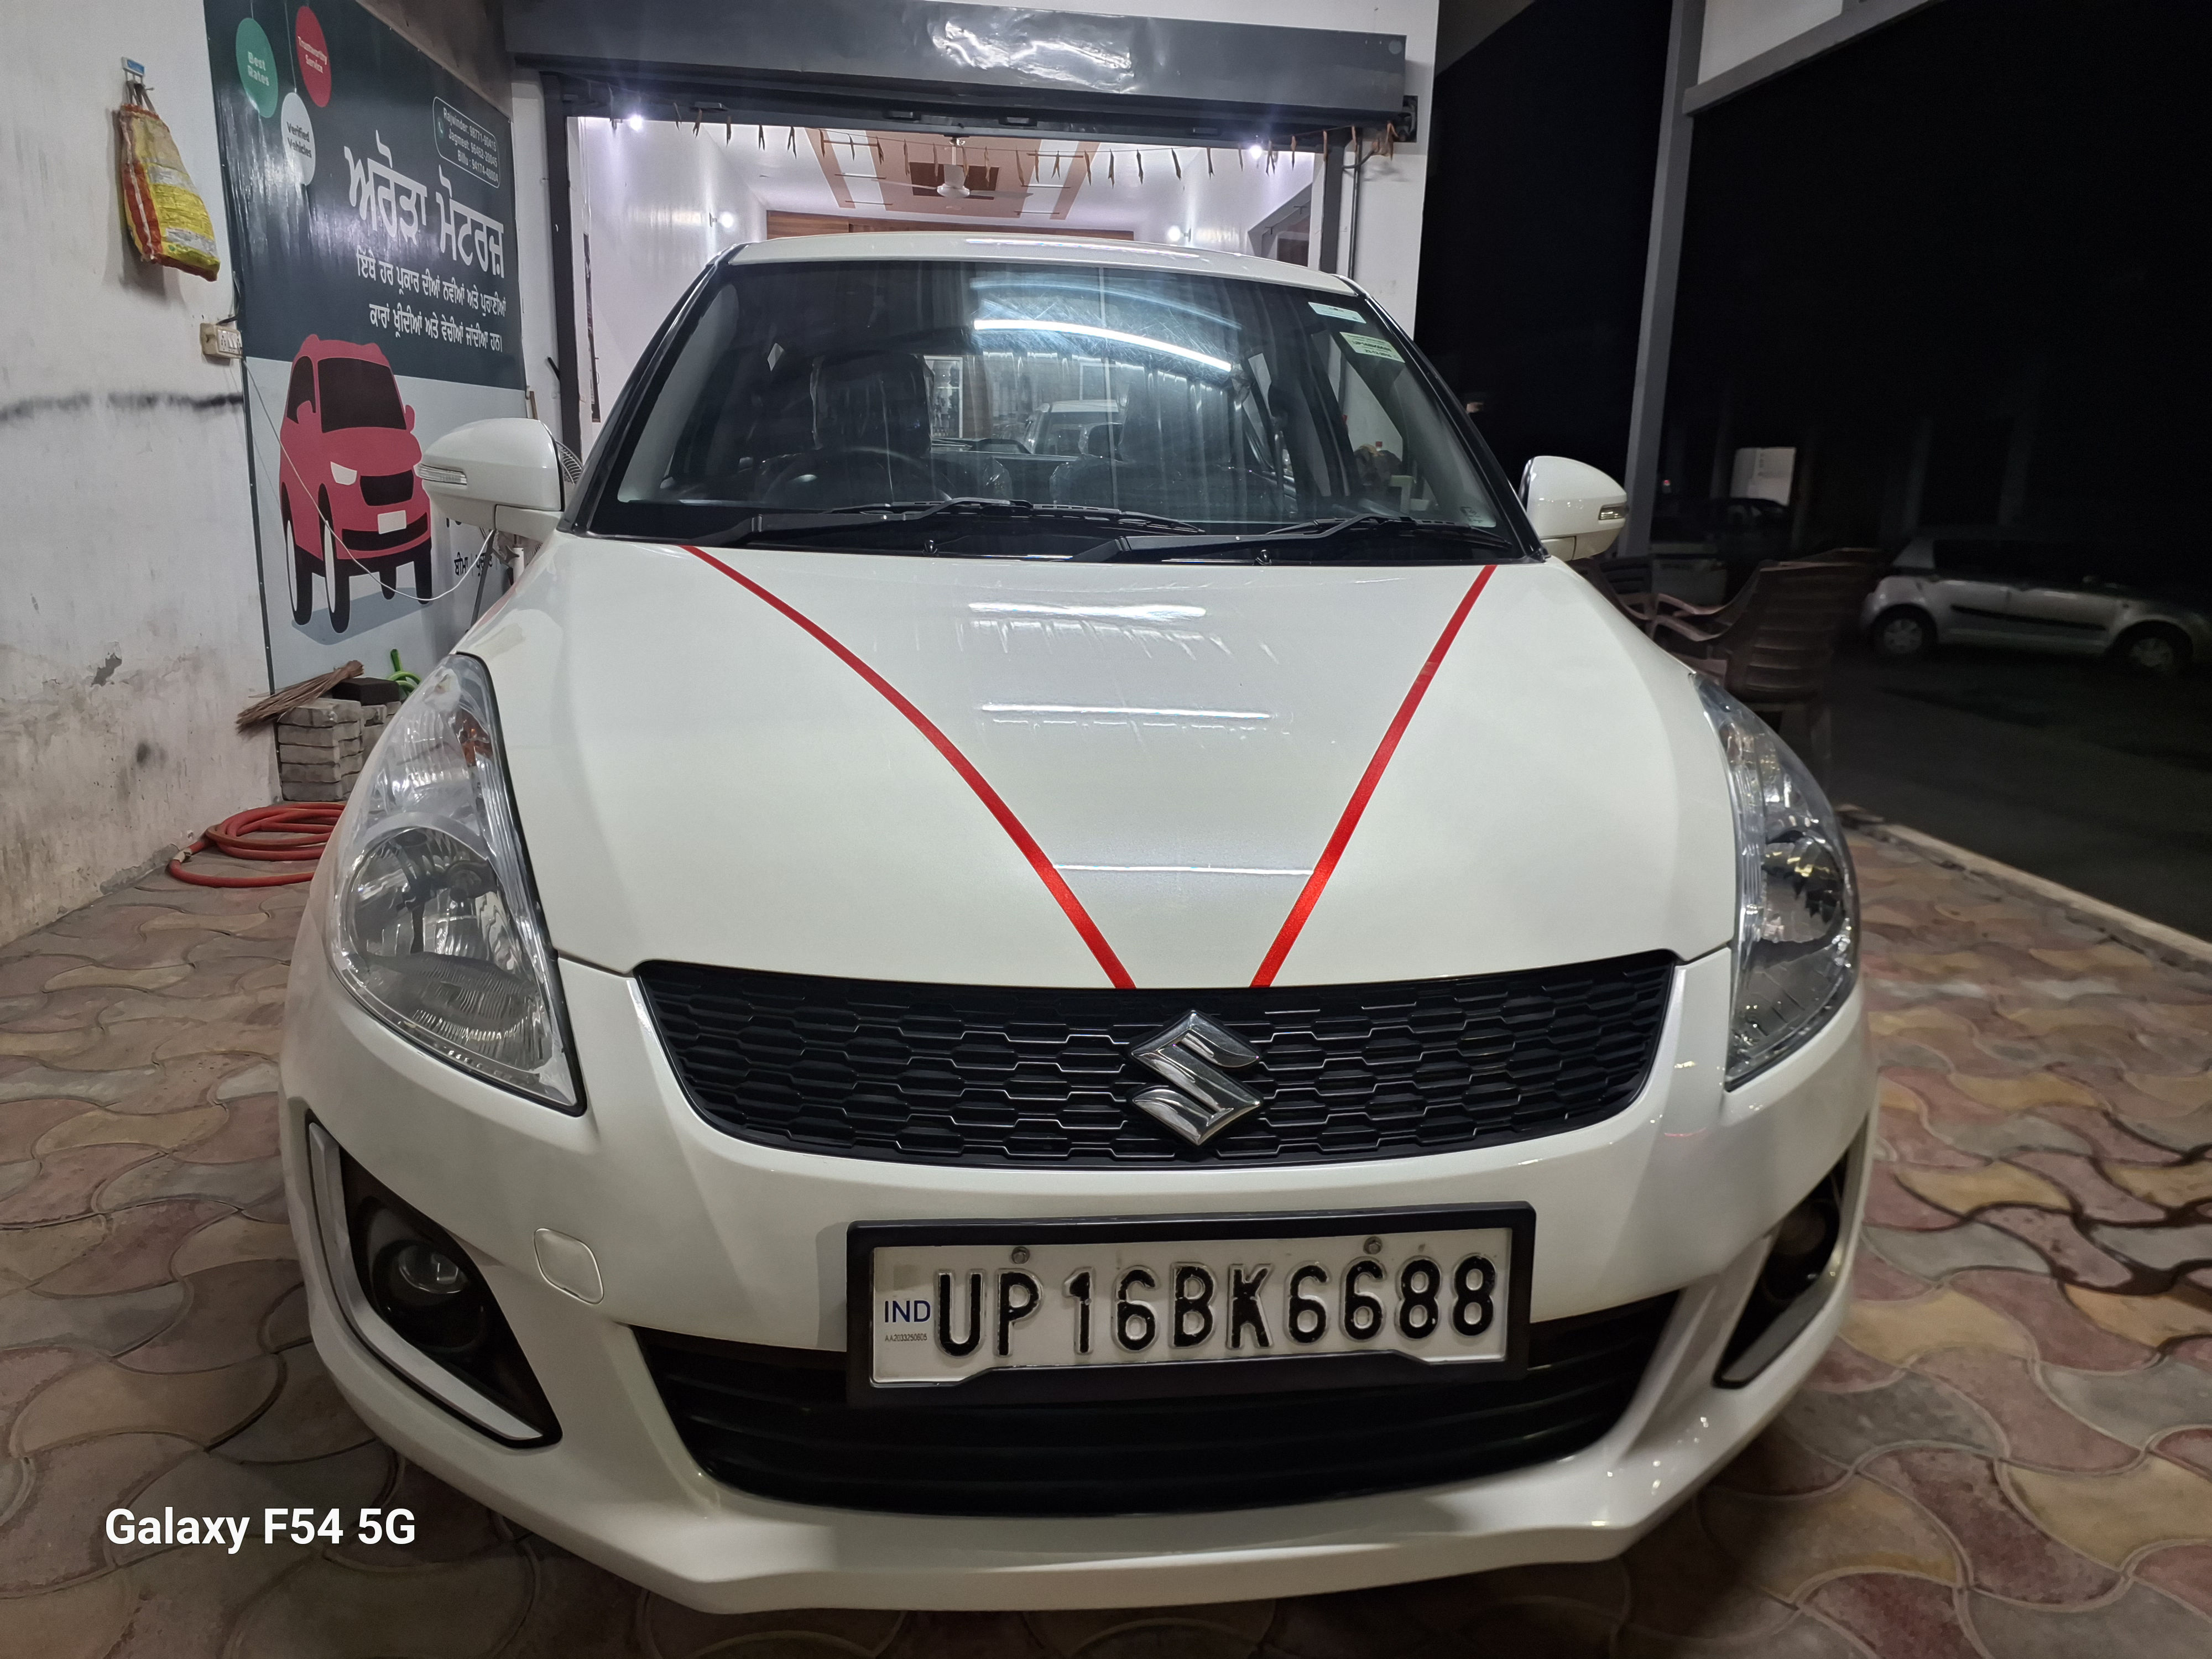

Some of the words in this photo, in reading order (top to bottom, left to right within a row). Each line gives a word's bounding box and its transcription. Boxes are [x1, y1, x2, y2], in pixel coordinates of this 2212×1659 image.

[247, 51, 266, 71] Best
[247, 65, 269, 86] Rates
[286, 121, 310, 143] Verified
[287, 137, 312, 159] Vehicles
[379, 260, 393, 285] ਹਰ
[396, 266, 419, 295] ਪ੍ਰਕਾਰ
[421, 268, 440, 298] ਦੀਆਂ
[442, 276, 465, 306] ਨਵੀਆਂ
[467, 284, 478, 310] ਅਤੇ
[480, 291, 506, 317] ਪੁਰਾਣੀਆਂ
[369, 302, 390, 328] ਕਾਰਾਂ
[424, 311, 439, 339] ਅਤੇ
[441, 314, 463, 344] ਵੇਚੀਆਂ
[885, 1300, 931, 1323] IND
